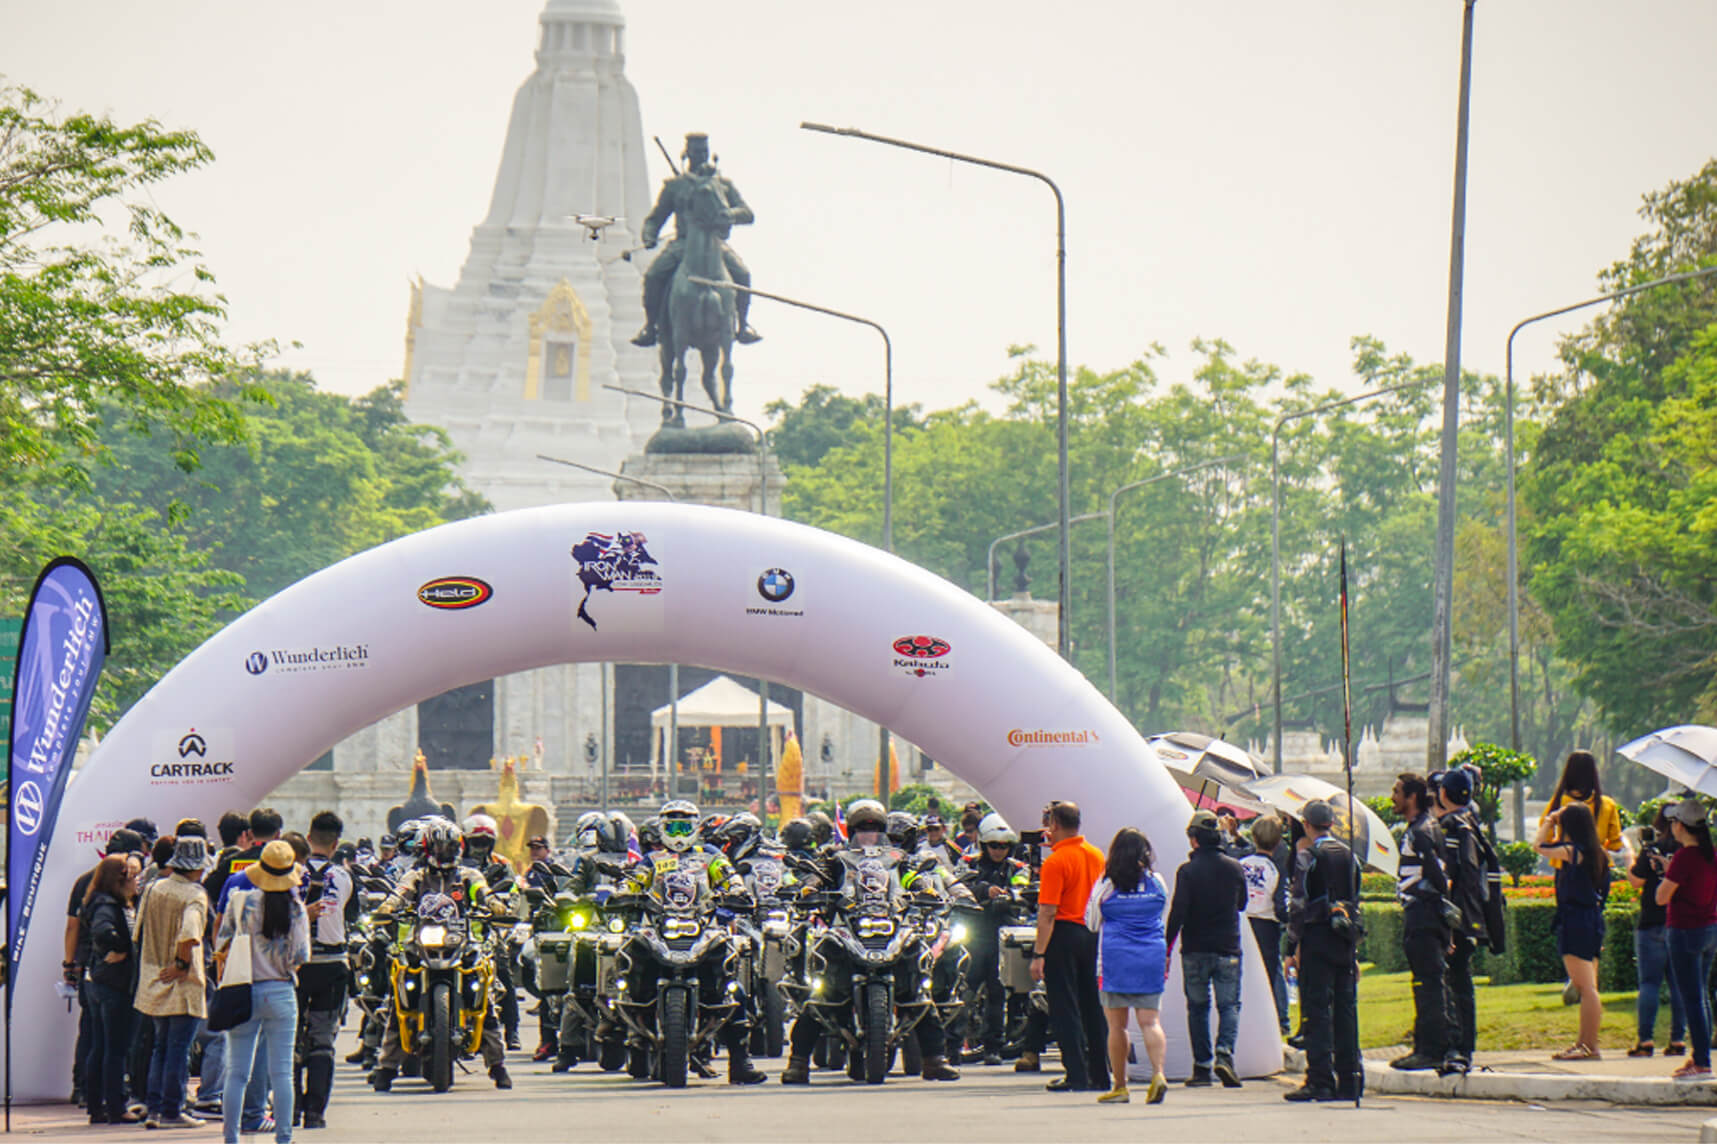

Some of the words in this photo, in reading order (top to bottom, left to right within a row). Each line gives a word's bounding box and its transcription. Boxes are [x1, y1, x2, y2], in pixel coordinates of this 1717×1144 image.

[271, 644, 369, 665] Wunderlich
[27, 595, 95, 774] Wunderlich
[1007, 728, 1088, 748] Continental
[150, 761, 234, 777] CARTRACK
[22, 842, 48, 918] BOUTIQUE
